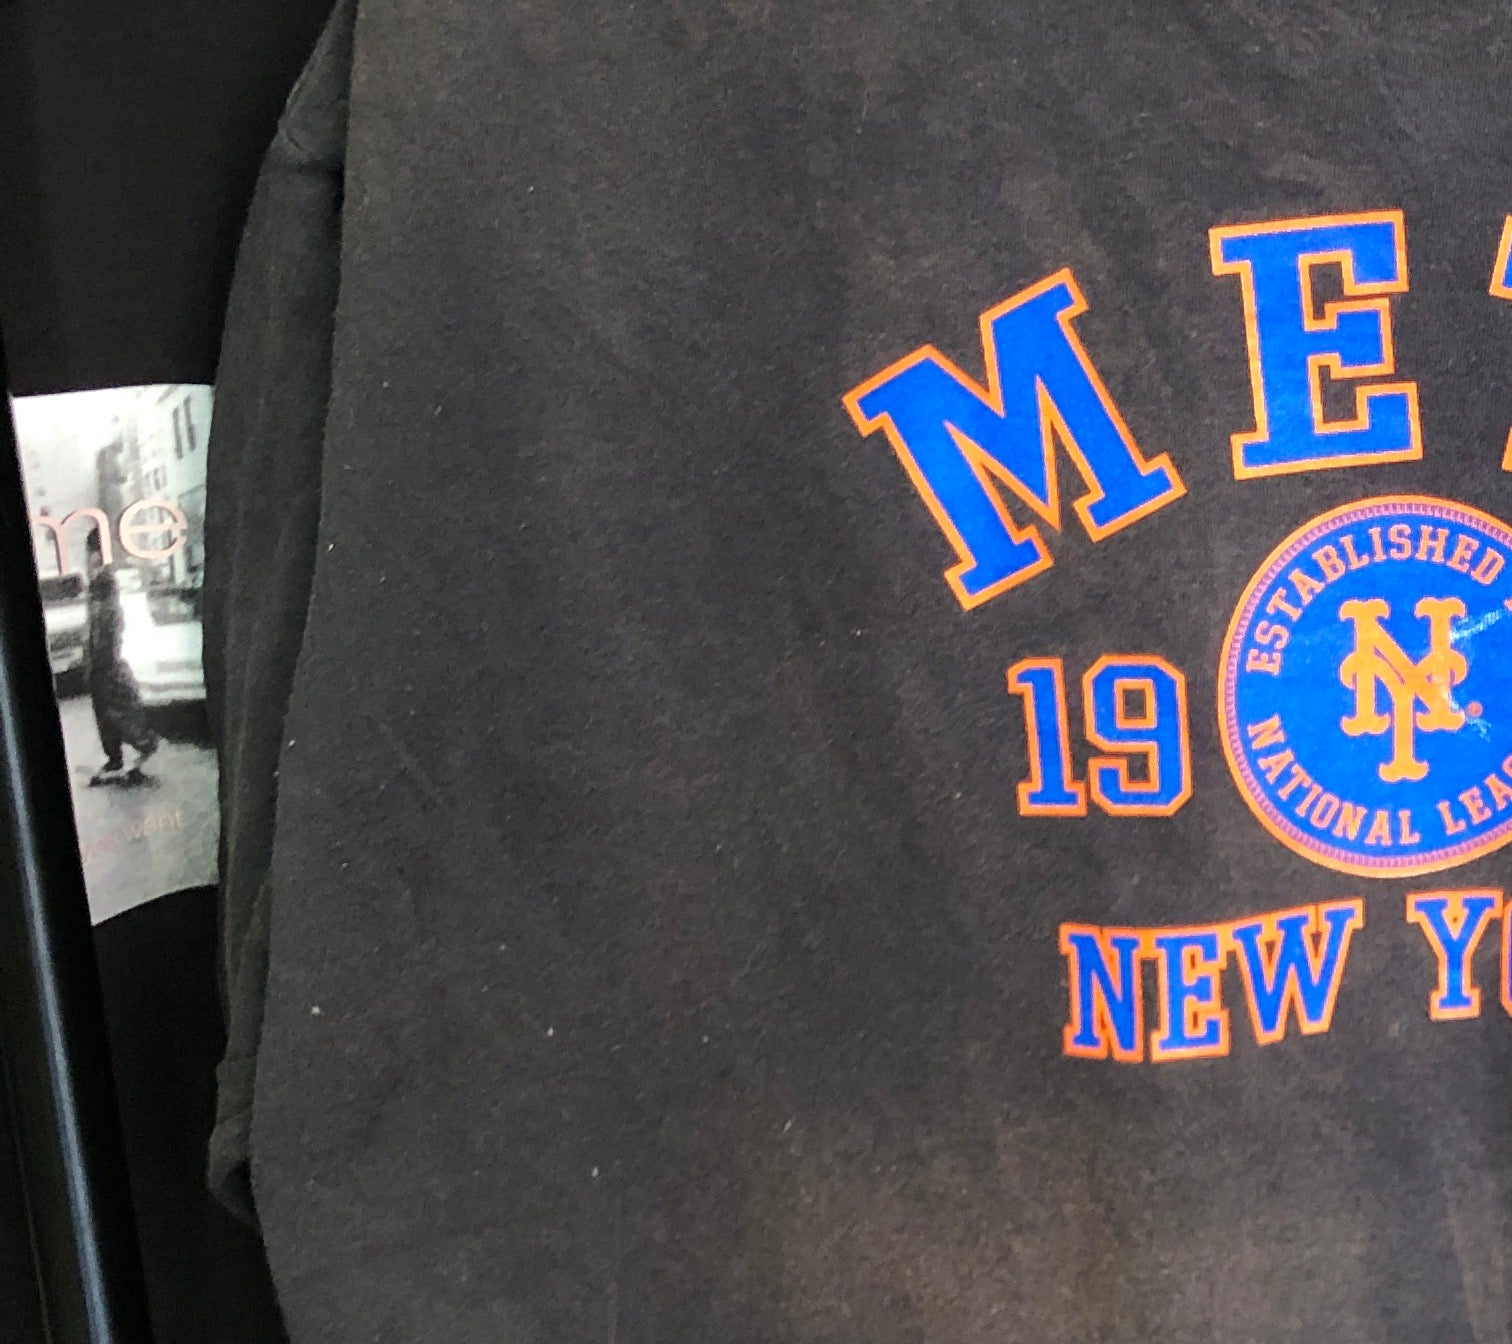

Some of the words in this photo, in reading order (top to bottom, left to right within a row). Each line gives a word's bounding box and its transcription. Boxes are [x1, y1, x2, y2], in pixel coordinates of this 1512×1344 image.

[1246, 523, 1505, 675] ESTABLISHED
[1008, 656, 1192, 817] 19
[1247, 713, 1420, 845] NATIONAL
[1059, 900, 1363, 1062] NEW
